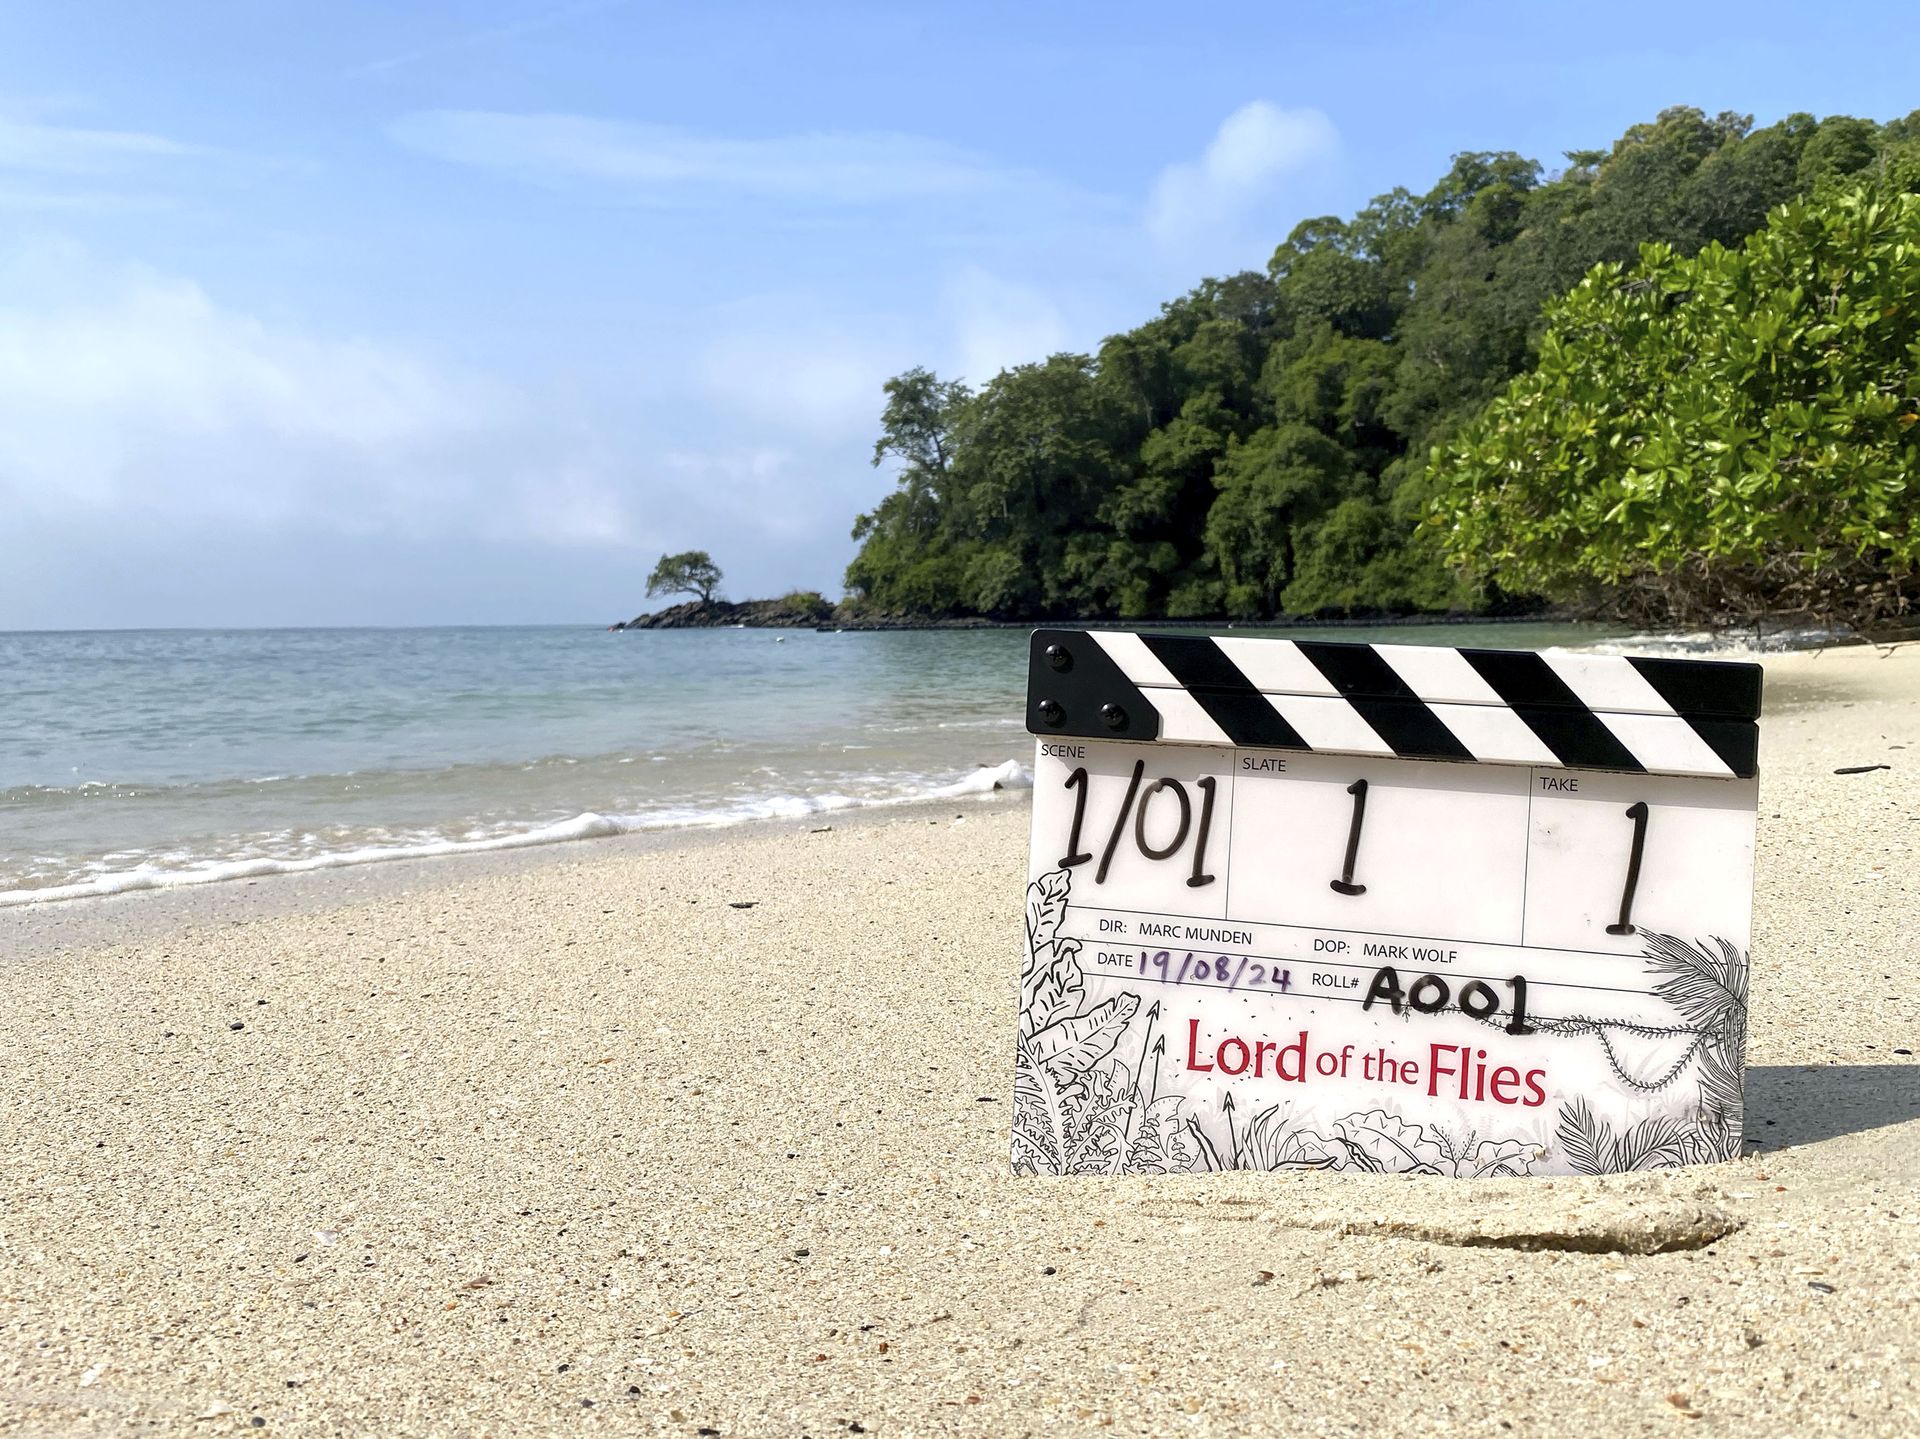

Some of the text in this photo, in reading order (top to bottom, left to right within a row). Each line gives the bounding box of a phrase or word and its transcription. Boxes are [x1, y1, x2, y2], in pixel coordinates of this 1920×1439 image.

[1041, 744, 1086, 759] SCENE
[1242, 757, 1287, 772] SLATE
[1539, 776, 1579, 792] TAKE
[1058, 759, 1216, 888] 1/01
[1330, 778, 1368, 896] 1
[1605, 801, 1649, 936] 1
[1099, 918, 1253, 945] DIR: MARC MUNDEN
[1097, 952, 1133, 968] DATE
[1313, 938, 1458, 964] DOP: MARK WOLF
[1138, 951, 1292, 993] 19/08/24
[1311, 972, 1360, 989] ROLL#
[1362, 966, 1536, 1036] A001
[1186, 1018, 1546, 1107] Lord of the Flies
